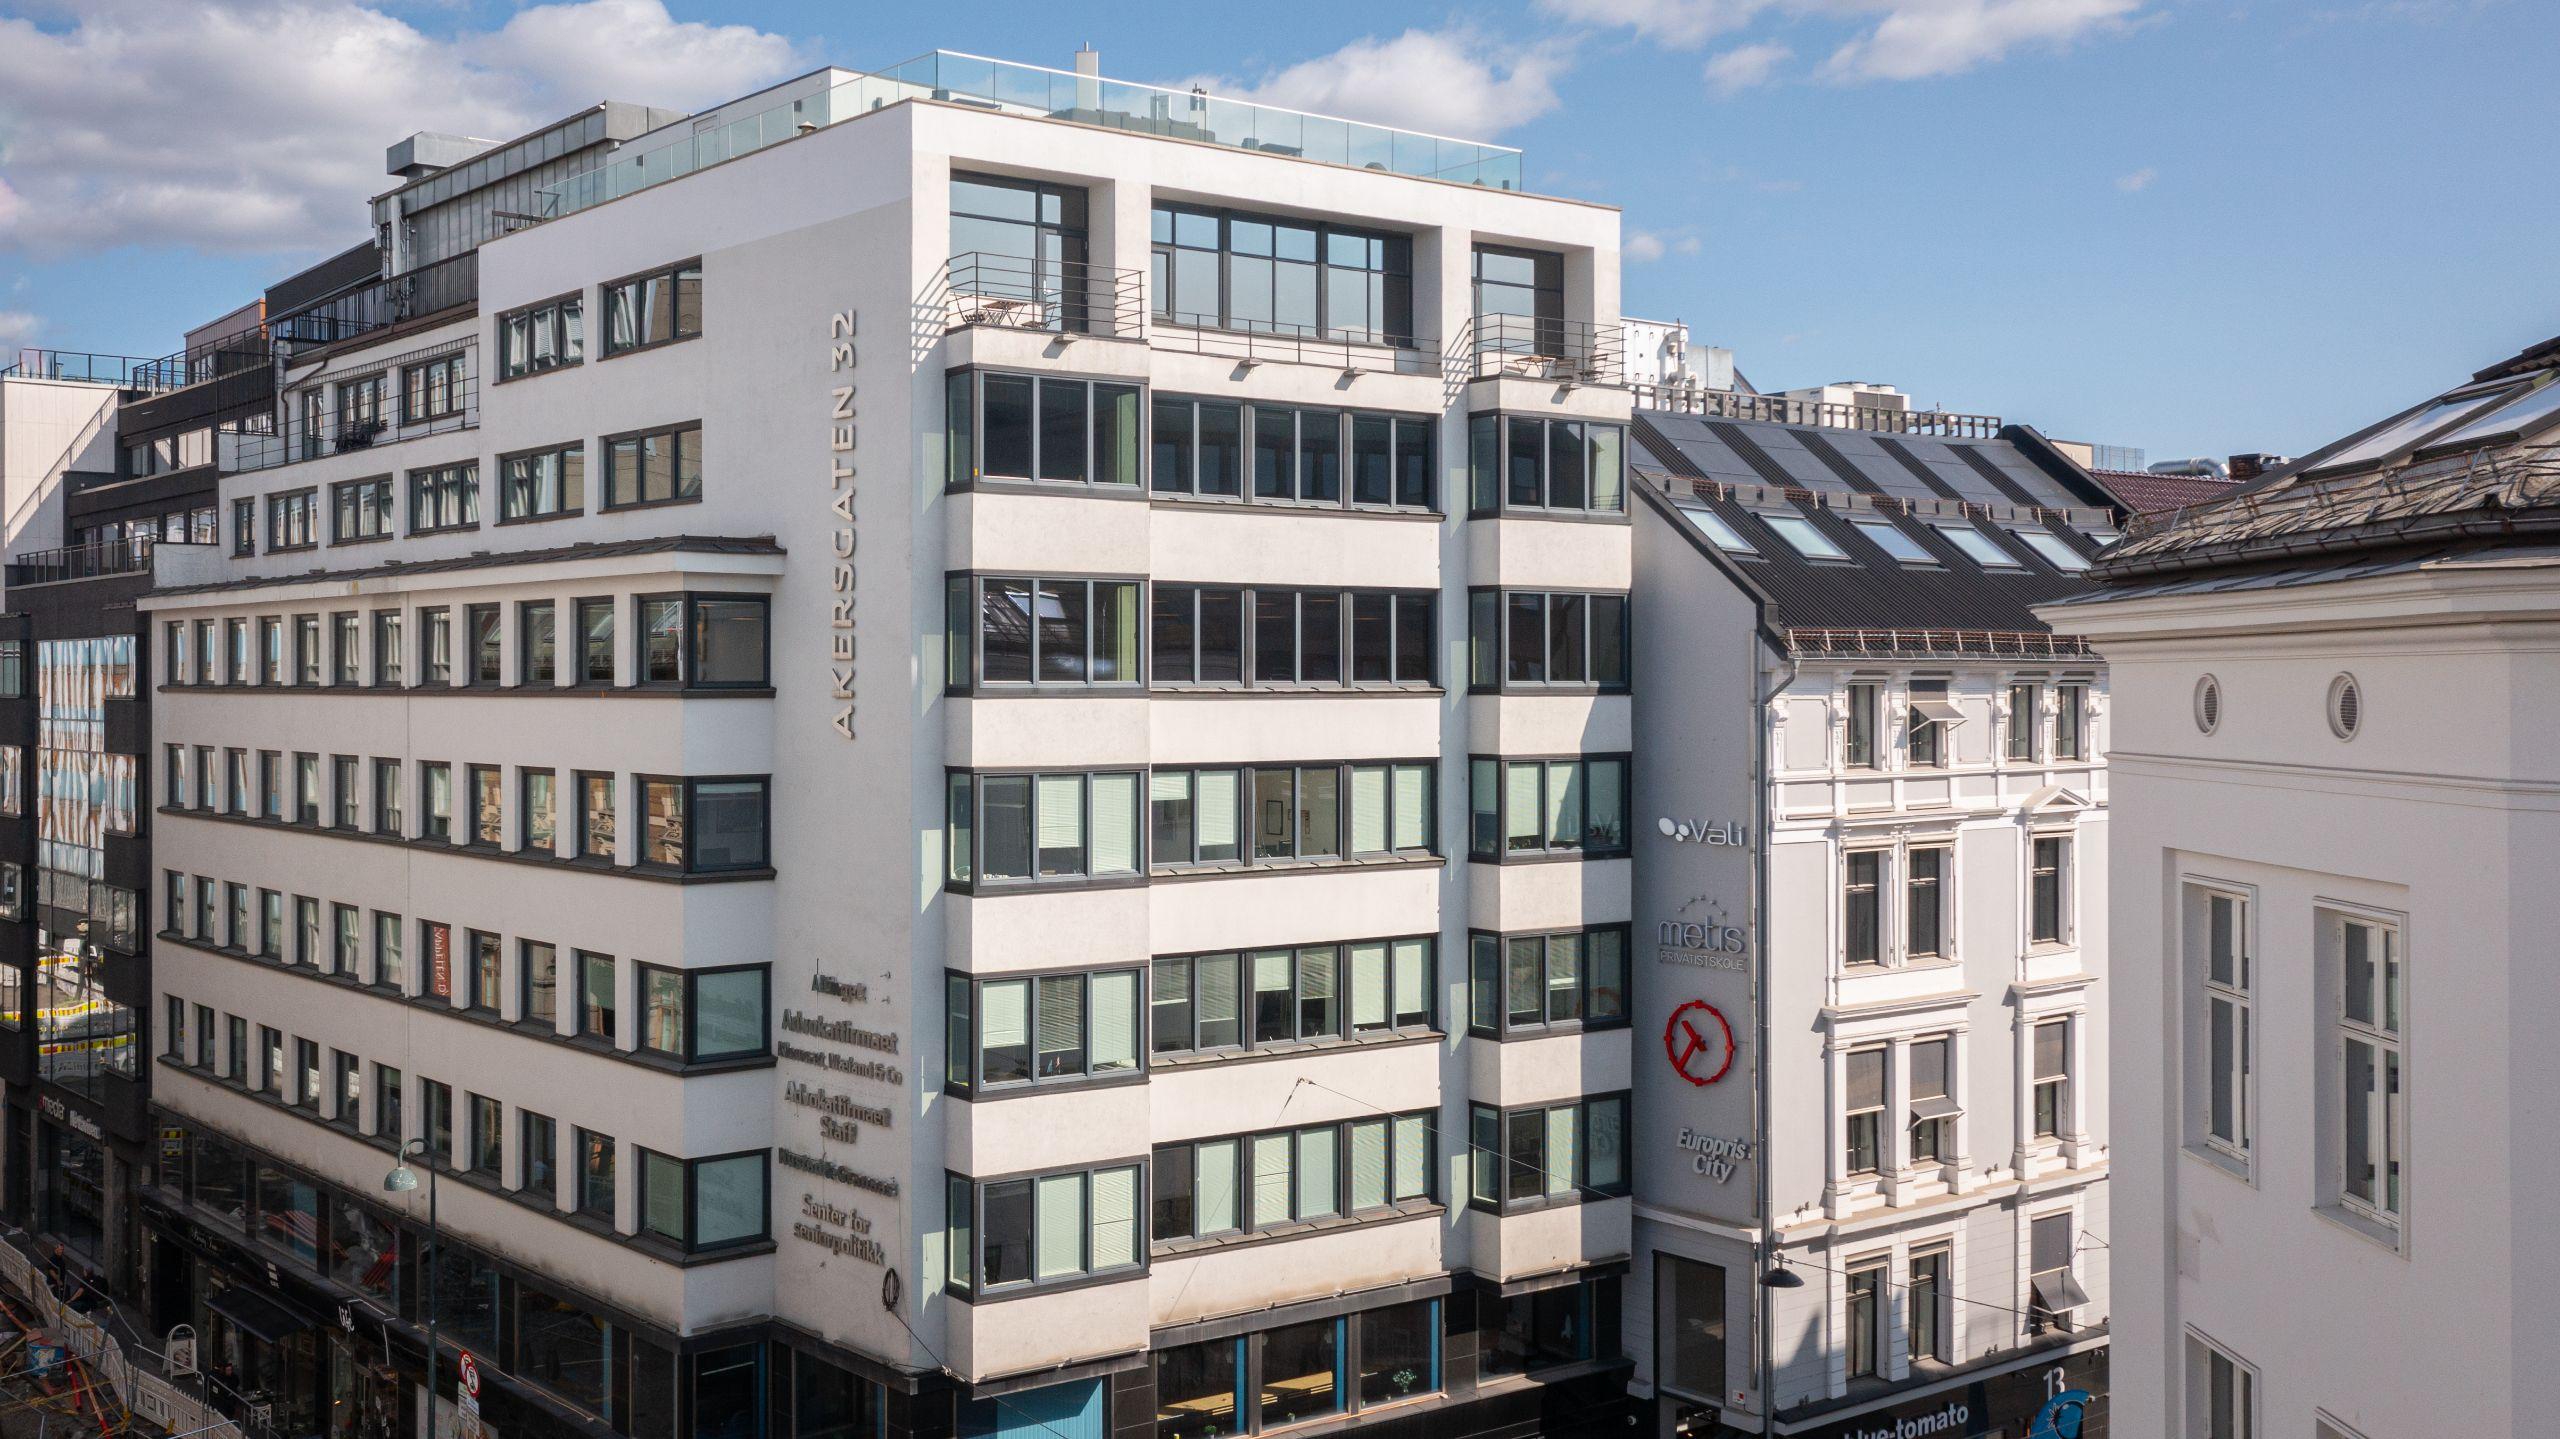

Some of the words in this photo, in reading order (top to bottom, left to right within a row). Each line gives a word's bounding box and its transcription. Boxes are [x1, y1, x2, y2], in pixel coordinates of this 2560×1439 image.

[831, 308, 856, 373] 32
[831, 385, 856, 741] AKERSGATEN
[1689, 819, 1744, 846] Vali
[1658, 915, 1745, 954] metis
[1660, 951, 1745, 971] PRIVATISTSKOLE
[781, 1008, 898, 1055] Advokatfirmaet
[784, 1080, 892, 1128] Advokatfirmaet
[1677, 1127, 1747, 1160] Europris
[1692, 1154, 1735, 1184] City
[802, 1193, 847, 1227] Senter
[849, 1207, 872, 1235] for
[793, 1222, 885, 1266] seniorpolitikk
[2043, 1366, 2066, 1402] 13
